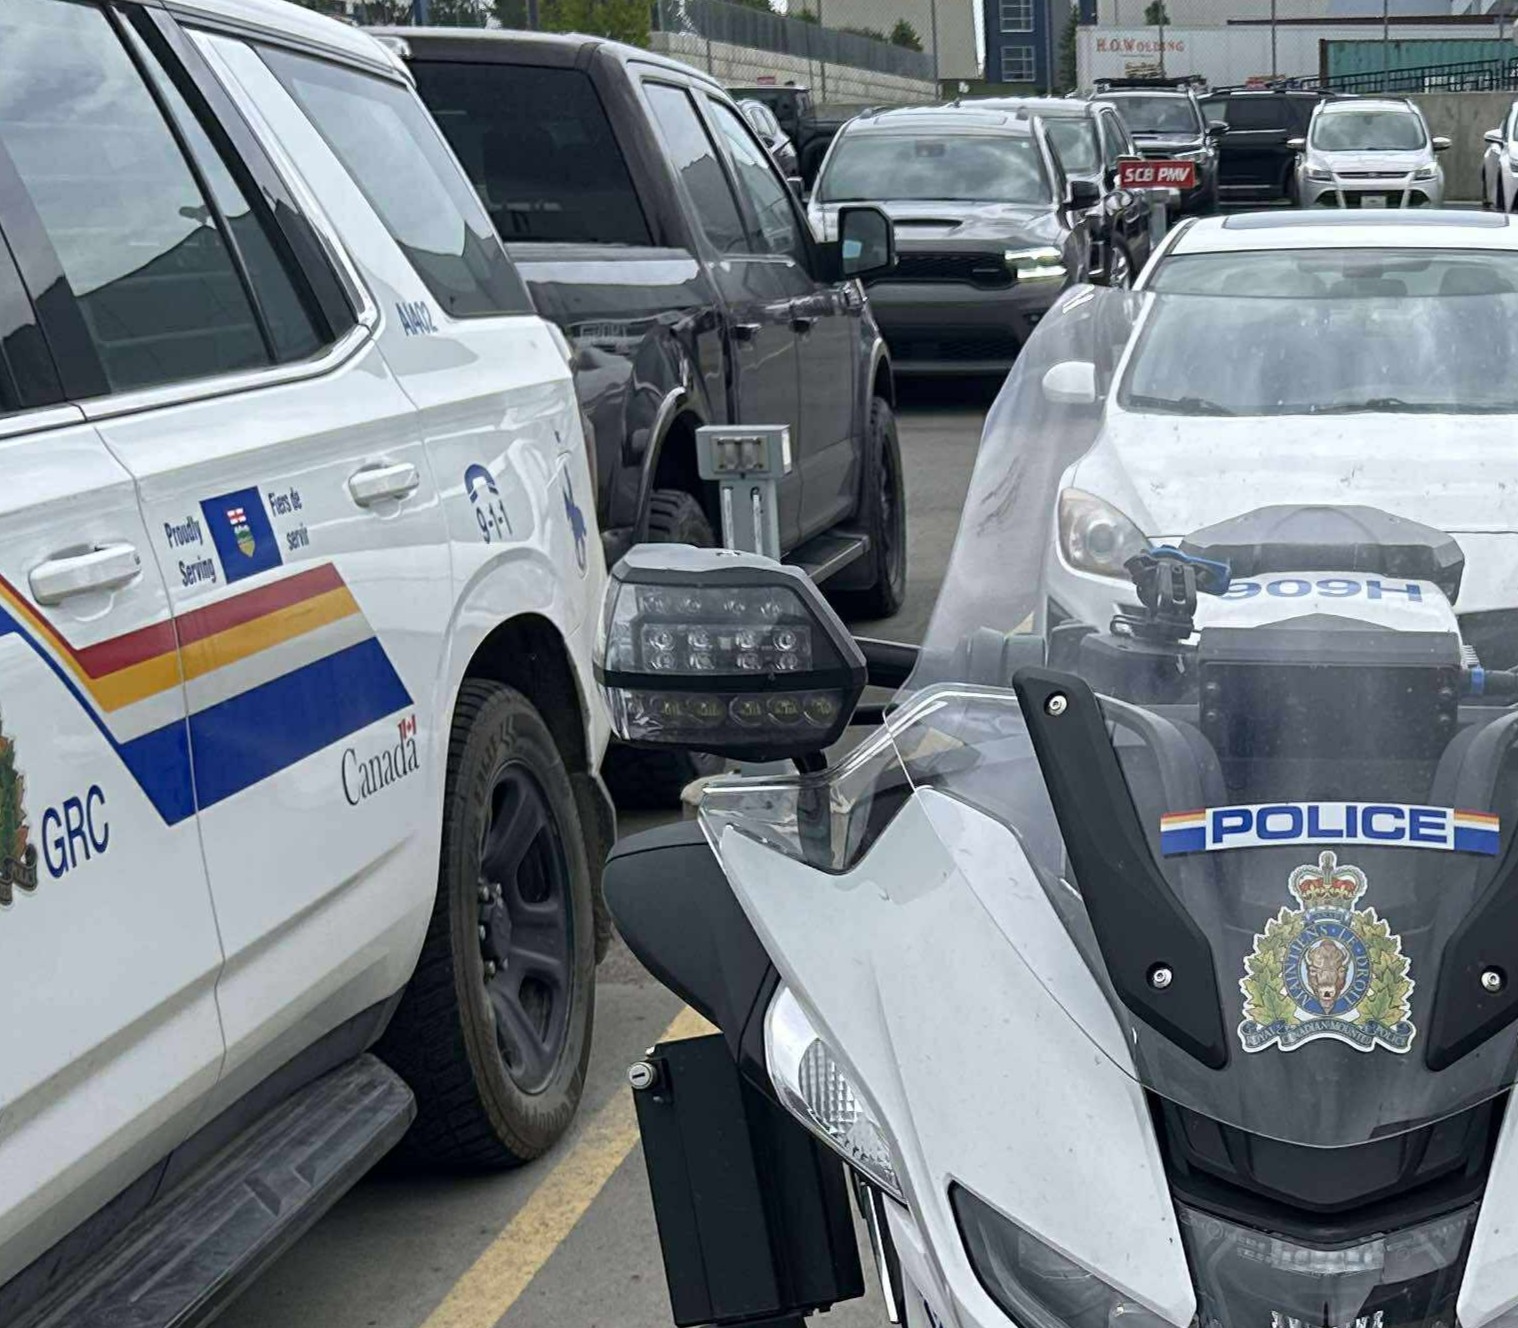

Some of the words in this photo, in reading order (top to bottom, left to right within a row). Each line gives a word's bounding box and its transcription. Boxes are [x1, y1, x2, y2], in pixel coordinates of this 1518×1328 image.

[1124, 167, 1154, 183] SCB
[1157, 167, 1191, 182] PMV
[267, 491, 292, 517] Fiers
[290, 486, 303, 511] de
[163, 515, 204, 548] Proudly
[286, 522, 310, 551] servir
[475, 499, 513, 545] 9-1-1
[178, 555, 217, 588] Serving
[341, 722, 420, 807] Canada
[41, 784, 110, 880] GRC
[1211, 804, 1449, 844] POLICE
